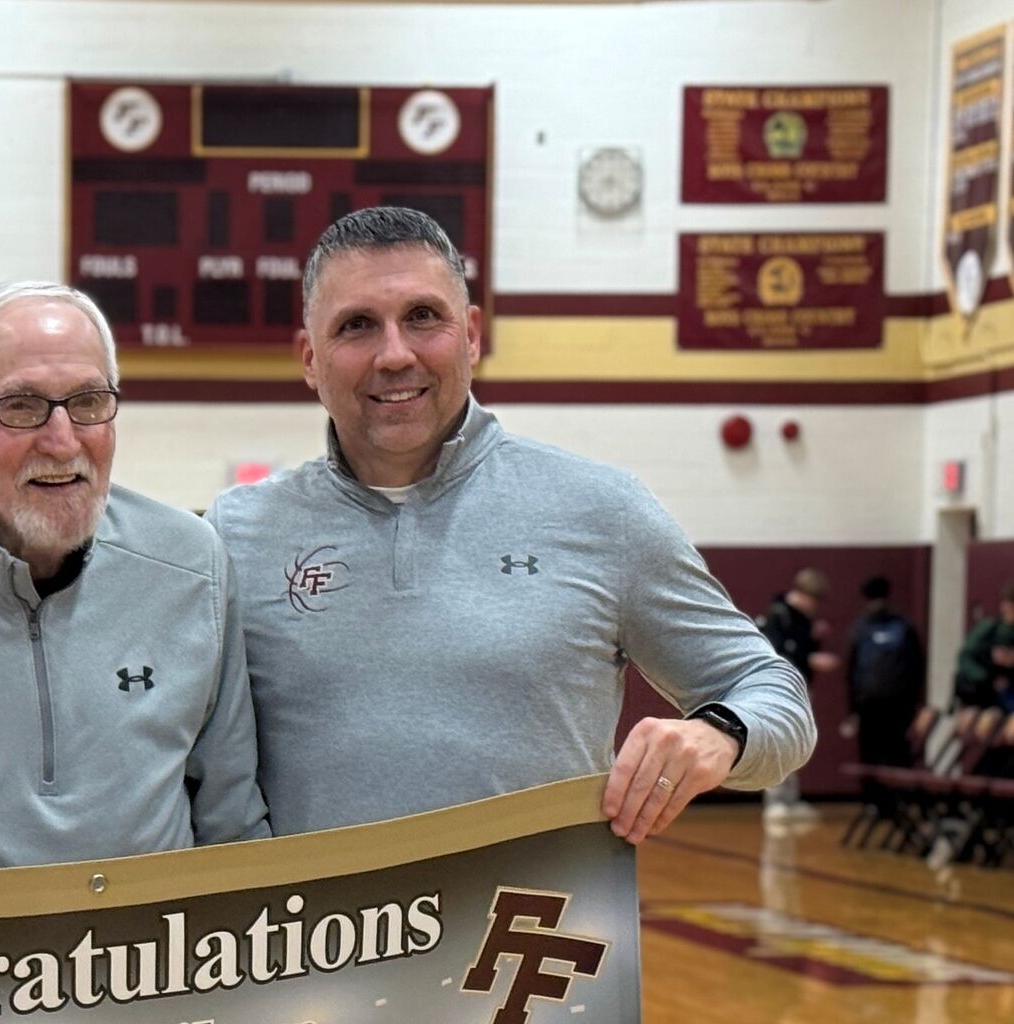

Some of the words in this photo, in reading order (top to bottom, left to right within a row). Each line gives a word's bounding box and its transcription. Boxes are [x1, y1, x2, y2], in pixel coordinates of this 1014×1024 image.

[248, 171, 312, 194] PERIOD
[79, 254, 137, 278] FOULS
[299, 566, 332, 596] FF
